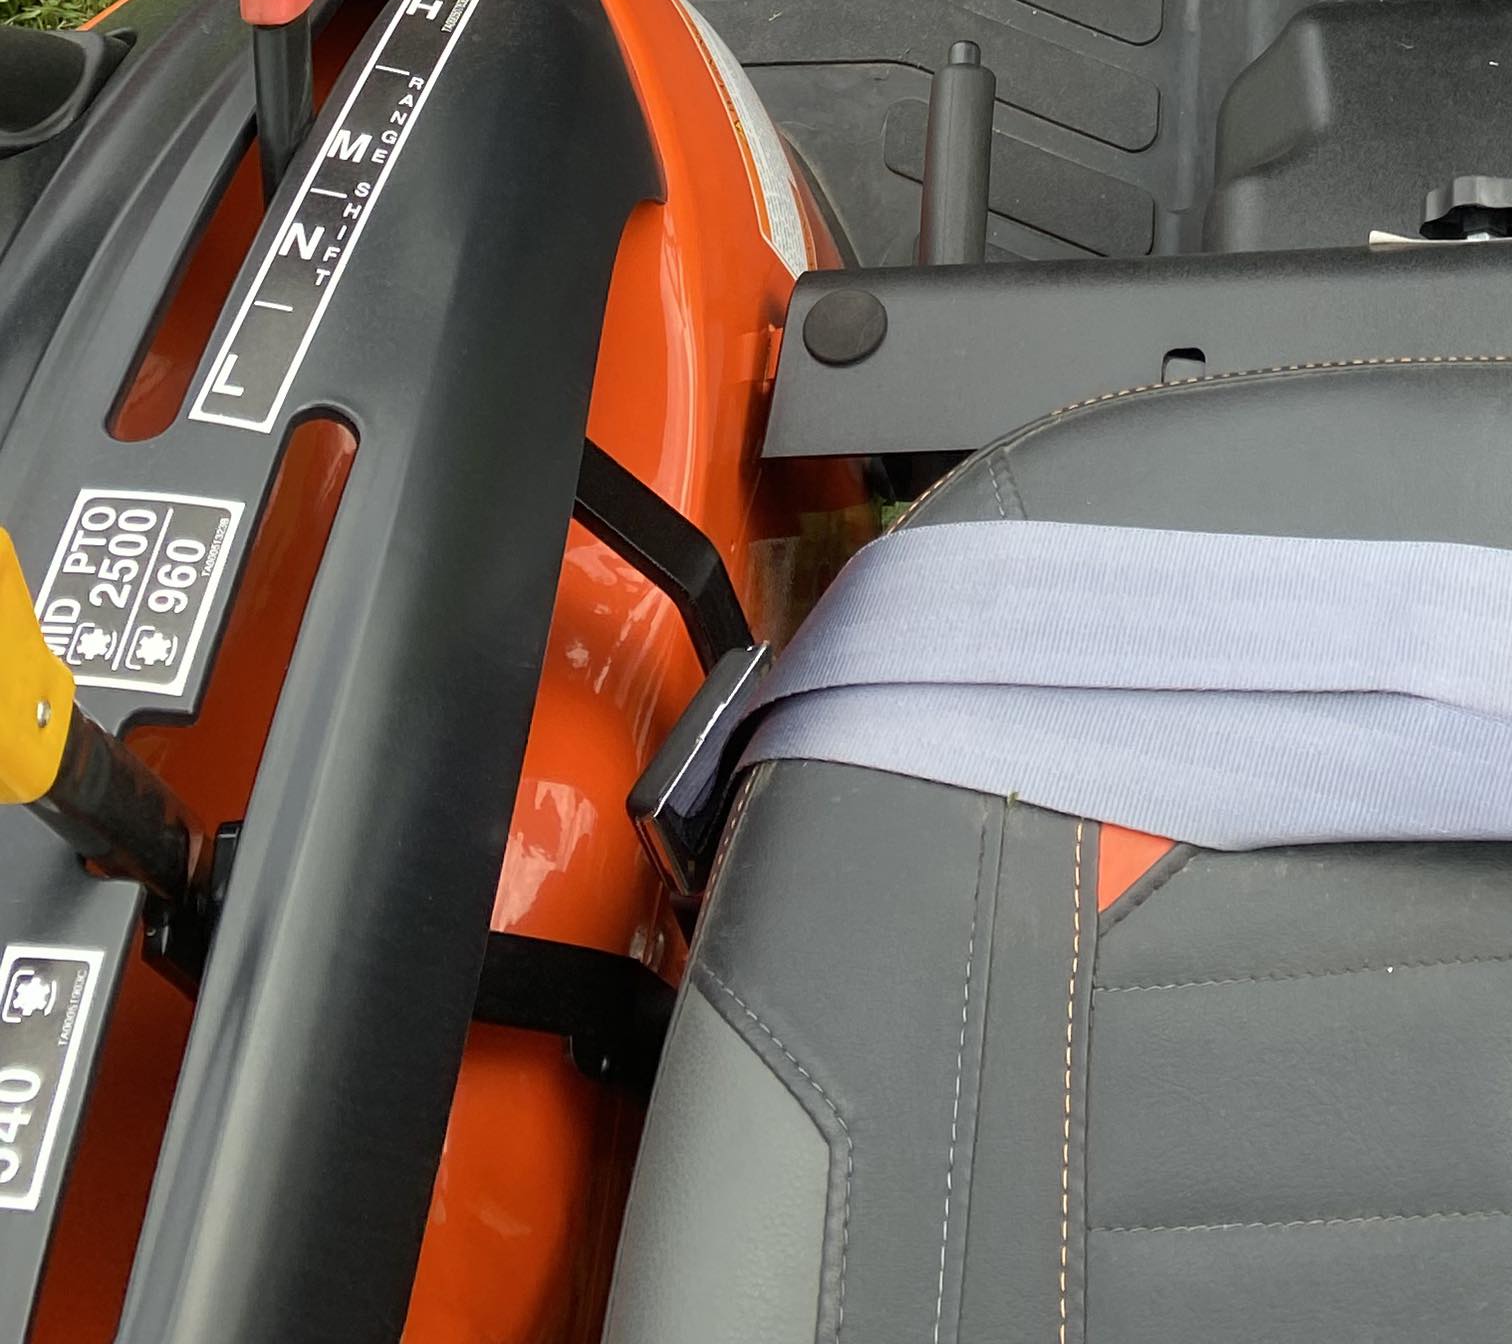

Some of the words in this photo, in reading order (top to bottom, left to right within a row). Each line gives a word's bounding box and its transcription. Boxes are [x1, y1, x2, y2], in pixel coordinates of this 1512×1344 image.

[327, 129, 373, 165] M
[371, 76, 425, 165] RANGE
[278, 222, 324, 261] N
[315, 182, 373, 287] SHIFT
[211, 353, 245, 396] L
[62, 506, 117, 574] PTO
[89, 508, 158, 609] 2500
[147, 539, 206, 614] 960
